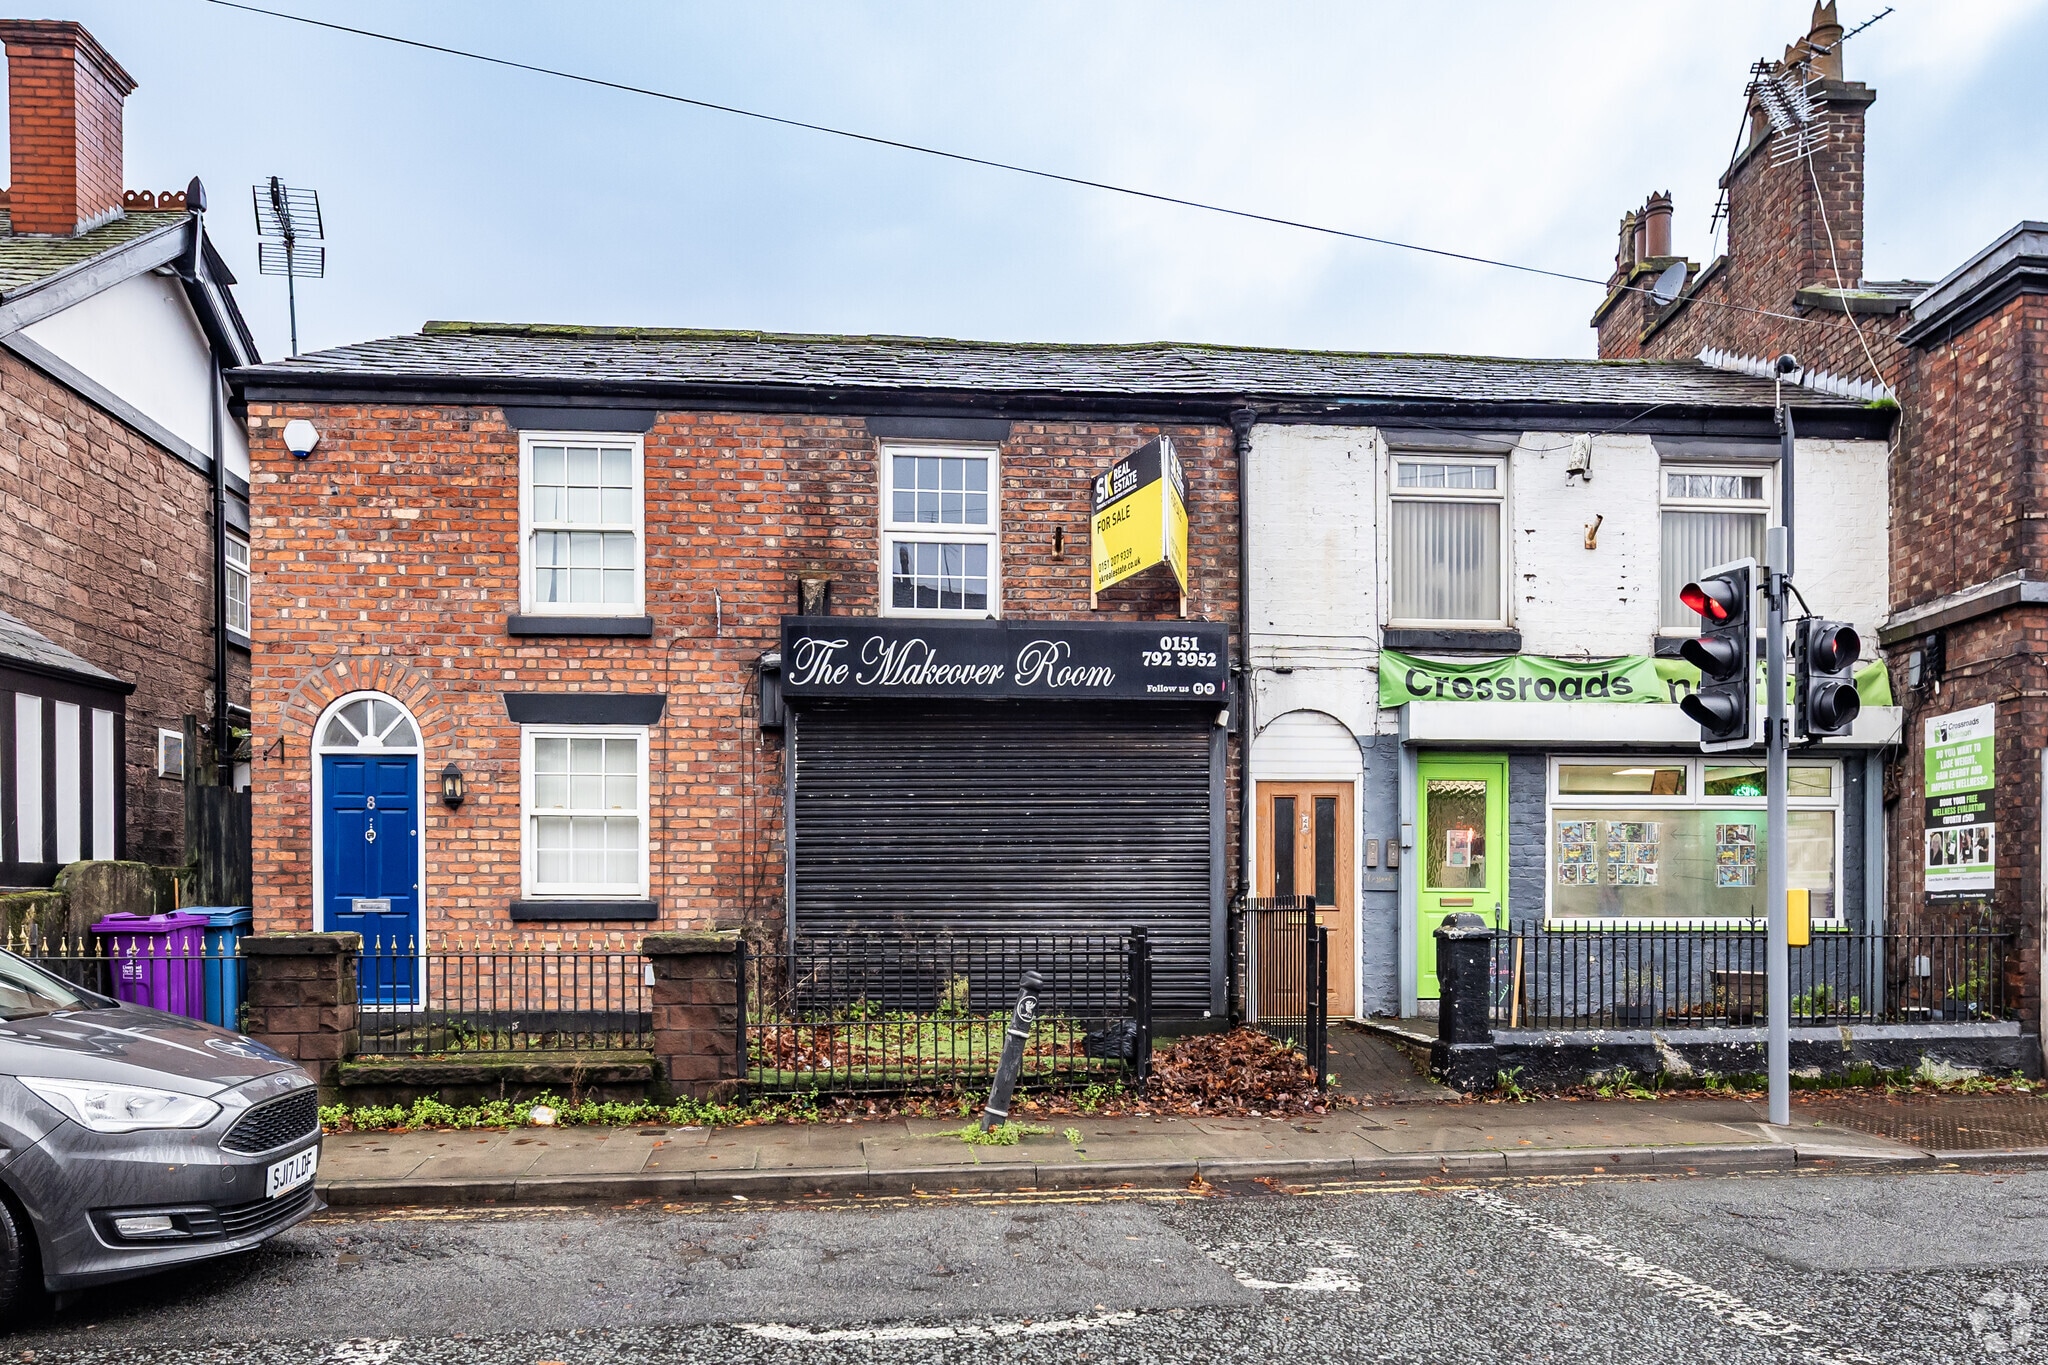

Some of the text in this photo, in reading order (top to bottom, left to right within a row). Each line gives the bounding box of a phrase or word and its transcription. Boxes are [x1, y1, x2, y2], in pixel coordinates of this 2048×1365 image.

[1113, 461, 1131, 481] REAL
[1096, 471, 1114, 504] SK
[1113, 469, 1138, 494] ESTATE
[1097, 504, 1131, 535] FOR SALE
[1098, 559, 1110, 573] 0151
[1098, 556, 1142, 585] skrealestate.co.uk
[1160, 636, 1200, 651] 0151
[789, 635, 1116, 688] The Makeover Room
[1142, 651, 1217, 667] 792 3952
[1146, 684, 1178, 693] Follow
[1405, 667, 1634, 701] Crossroads
[1948, 718, 1980, 731] Crossroads
[1944, 747, 1956, 758] YOU
[1956, 744, 1973, 756] WANT
[1973, 742, 1982, 753] TO
[1940, 759, 1954, 769] LOSE
[367, 796, 376, 810] 8
[1966, 793, 1978, 804] FREE
[273, 1160, 295, 1190] SJ17
[295, 1151, 313, 1180] LDF
